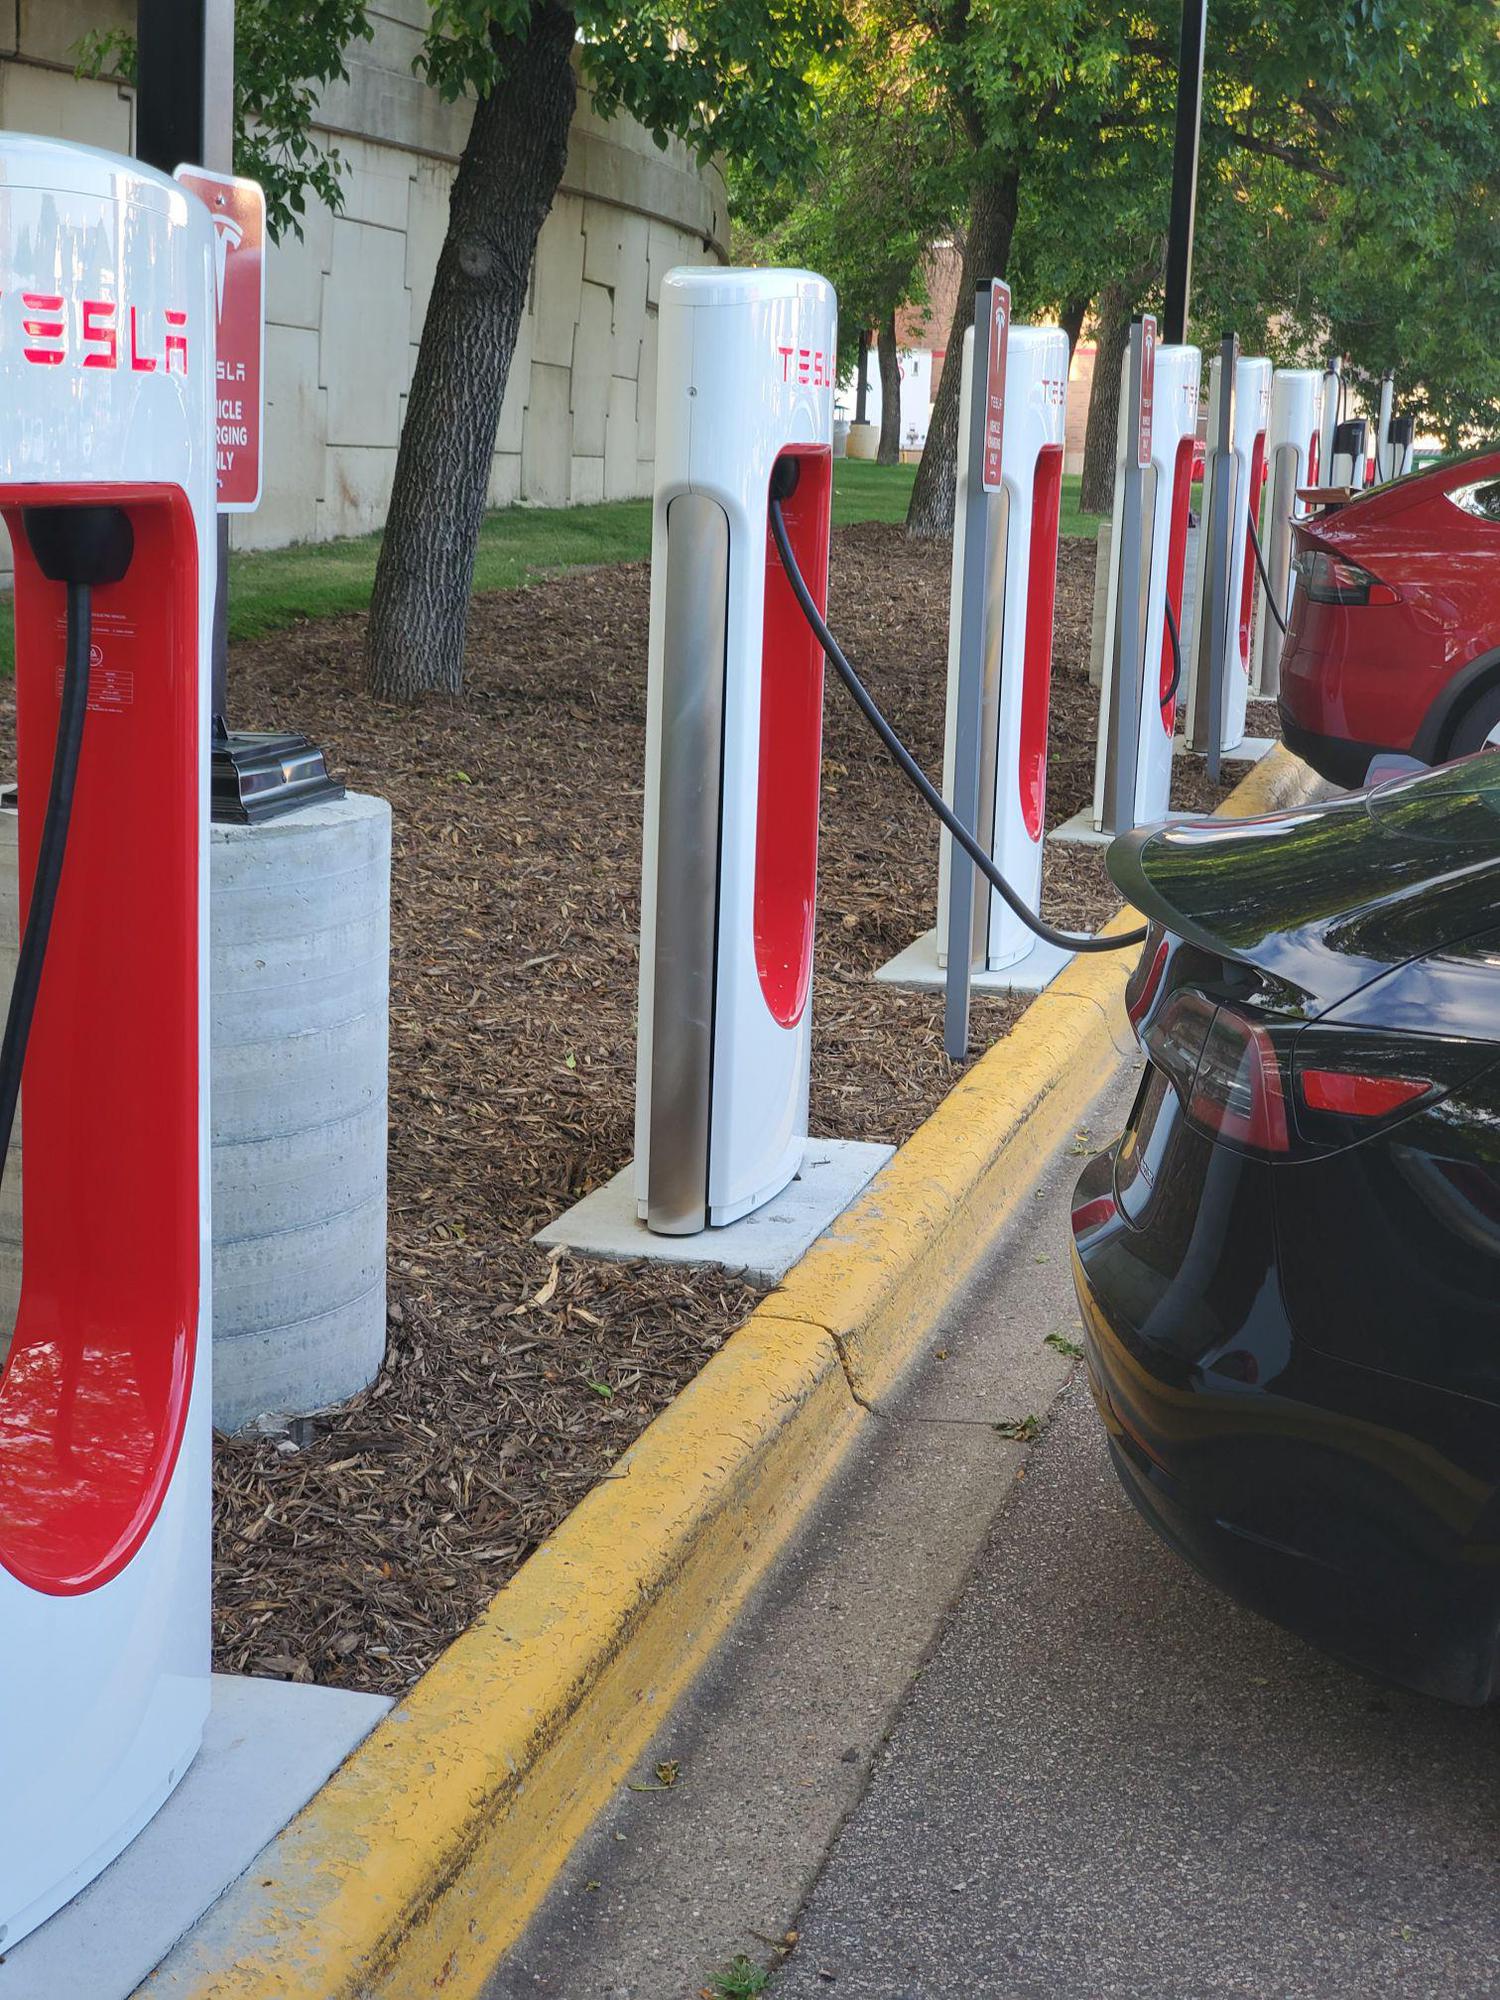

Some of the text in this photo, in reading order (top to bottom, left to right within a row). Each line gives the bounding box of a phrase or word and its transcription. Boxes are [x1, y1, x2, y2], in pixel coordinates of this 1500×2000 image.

[21, 292, 188, 376] ESLA
[216, 361, 246, 382] SLA
[217, 400, 243, 420] ICLE
[216, 425, 248, 446] RGING
[216, 451, 235, 471] NLY
